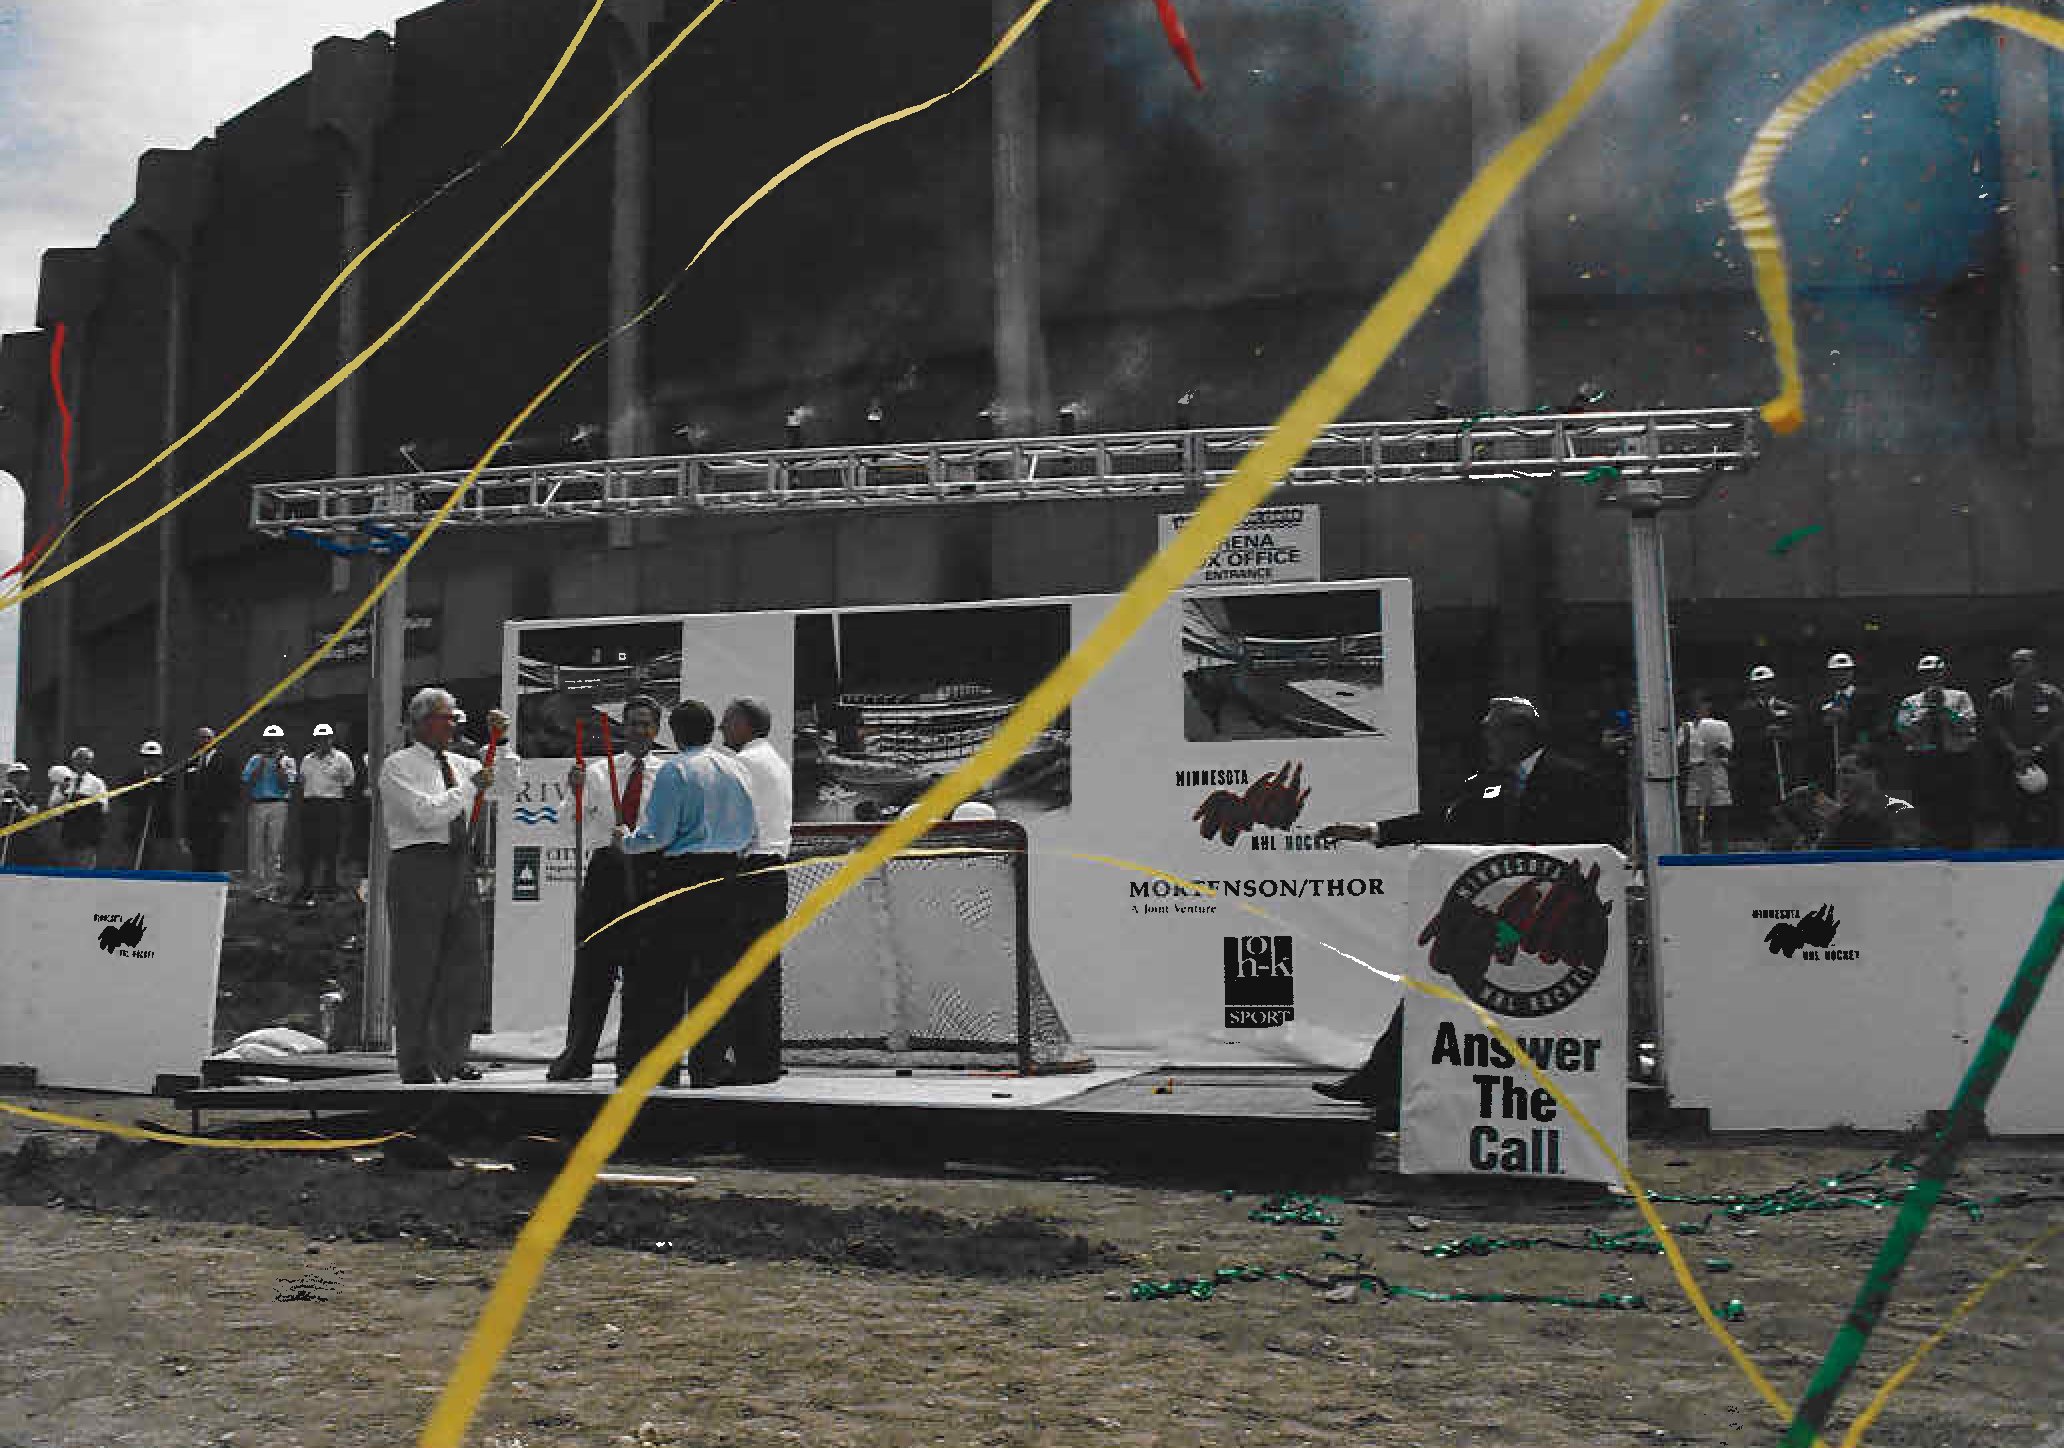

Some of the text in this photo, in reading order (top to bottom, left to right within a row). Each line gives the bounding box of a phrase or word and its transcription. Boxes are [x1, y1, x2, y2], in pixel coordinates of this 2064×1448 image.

[1216, 533, 1275, 551] RENA
[1227, 550, 1301, 567] OFFICE
[1205, 568, 1273, 581] ENTRANCE
[1175, 769, 1249, 787] MINNESOTA
[1251, 835, 1277, 851] NHL
[1229, 1010, 1291, 1024] SPORT
[1431, 1021, 1601, 1073] Answer
[1472, 1074, 1557, 1123] The
